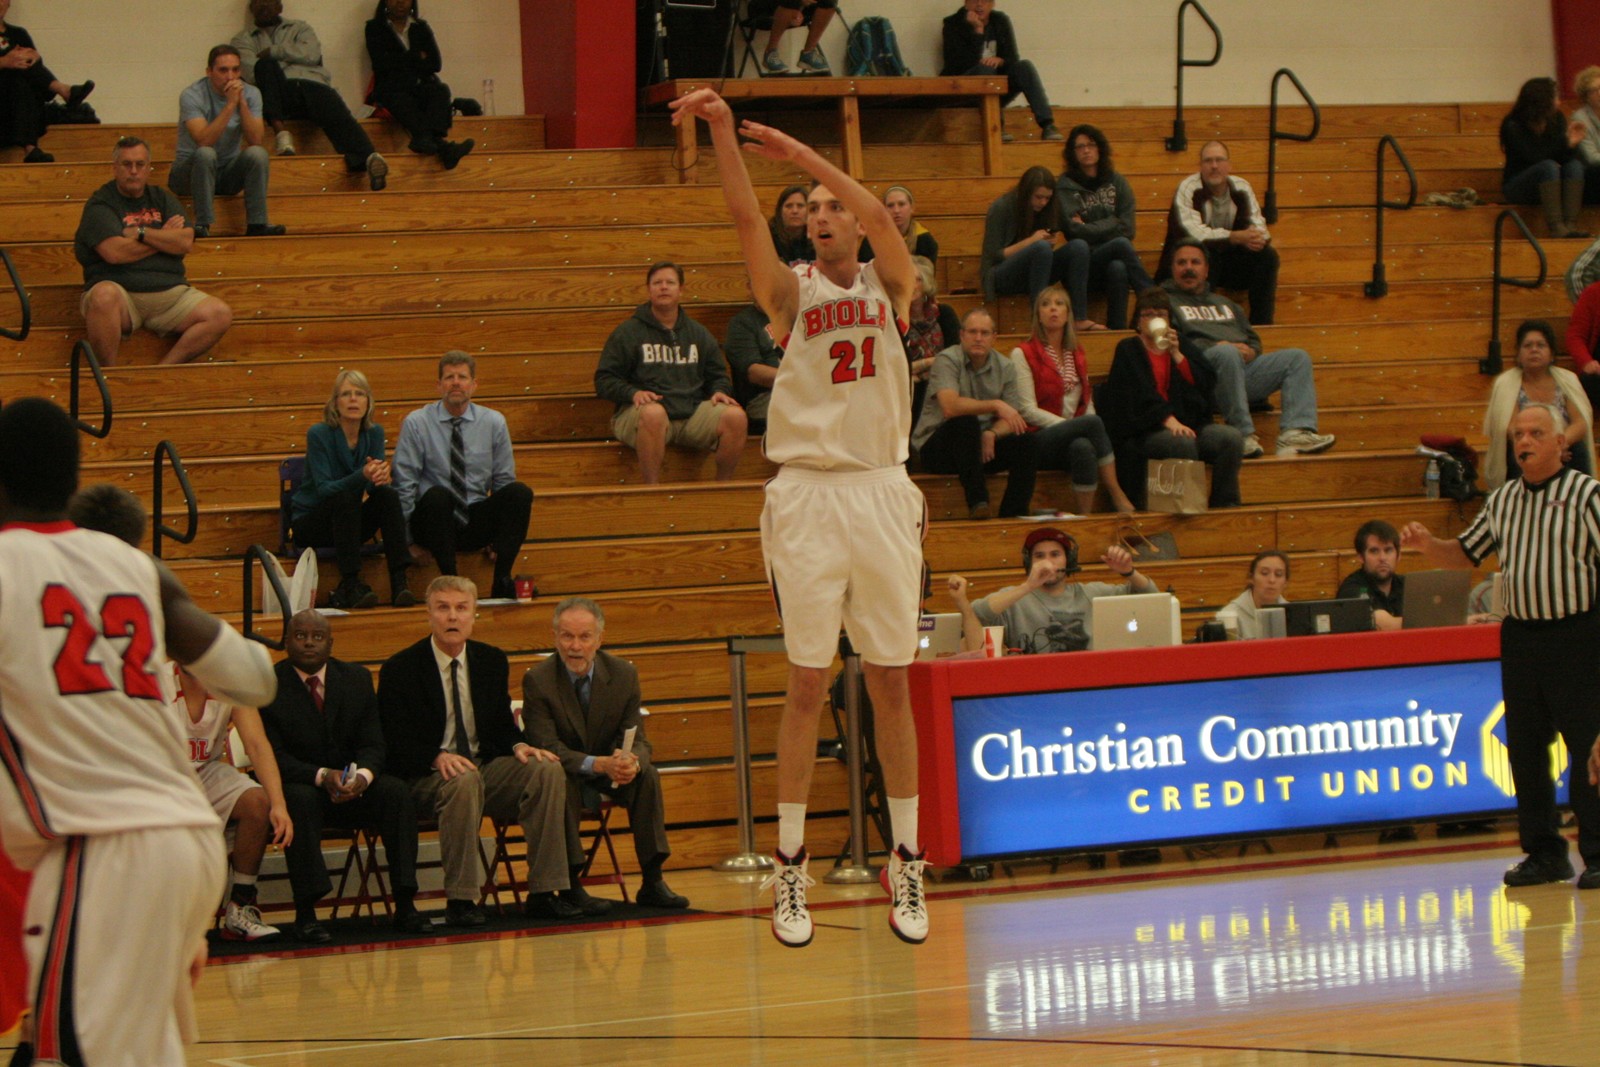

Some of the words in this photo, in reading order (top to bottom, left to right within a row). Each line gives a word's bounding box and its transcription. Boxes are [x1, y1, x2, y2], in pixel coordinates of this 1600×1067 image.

[1180, 304, 1234, 320] BIOLA
[641, 343, 699, 364] BIOLA
[829, 336, 876, 384] 21
[41, 582, 165, 705] 22
[971, 722, 1187, 782] Christian
[1199, 699, 1463, 764] Community
[1127, 775, 1295, 814] CREDIT
[1321, 760, 1469, 798] UNION
